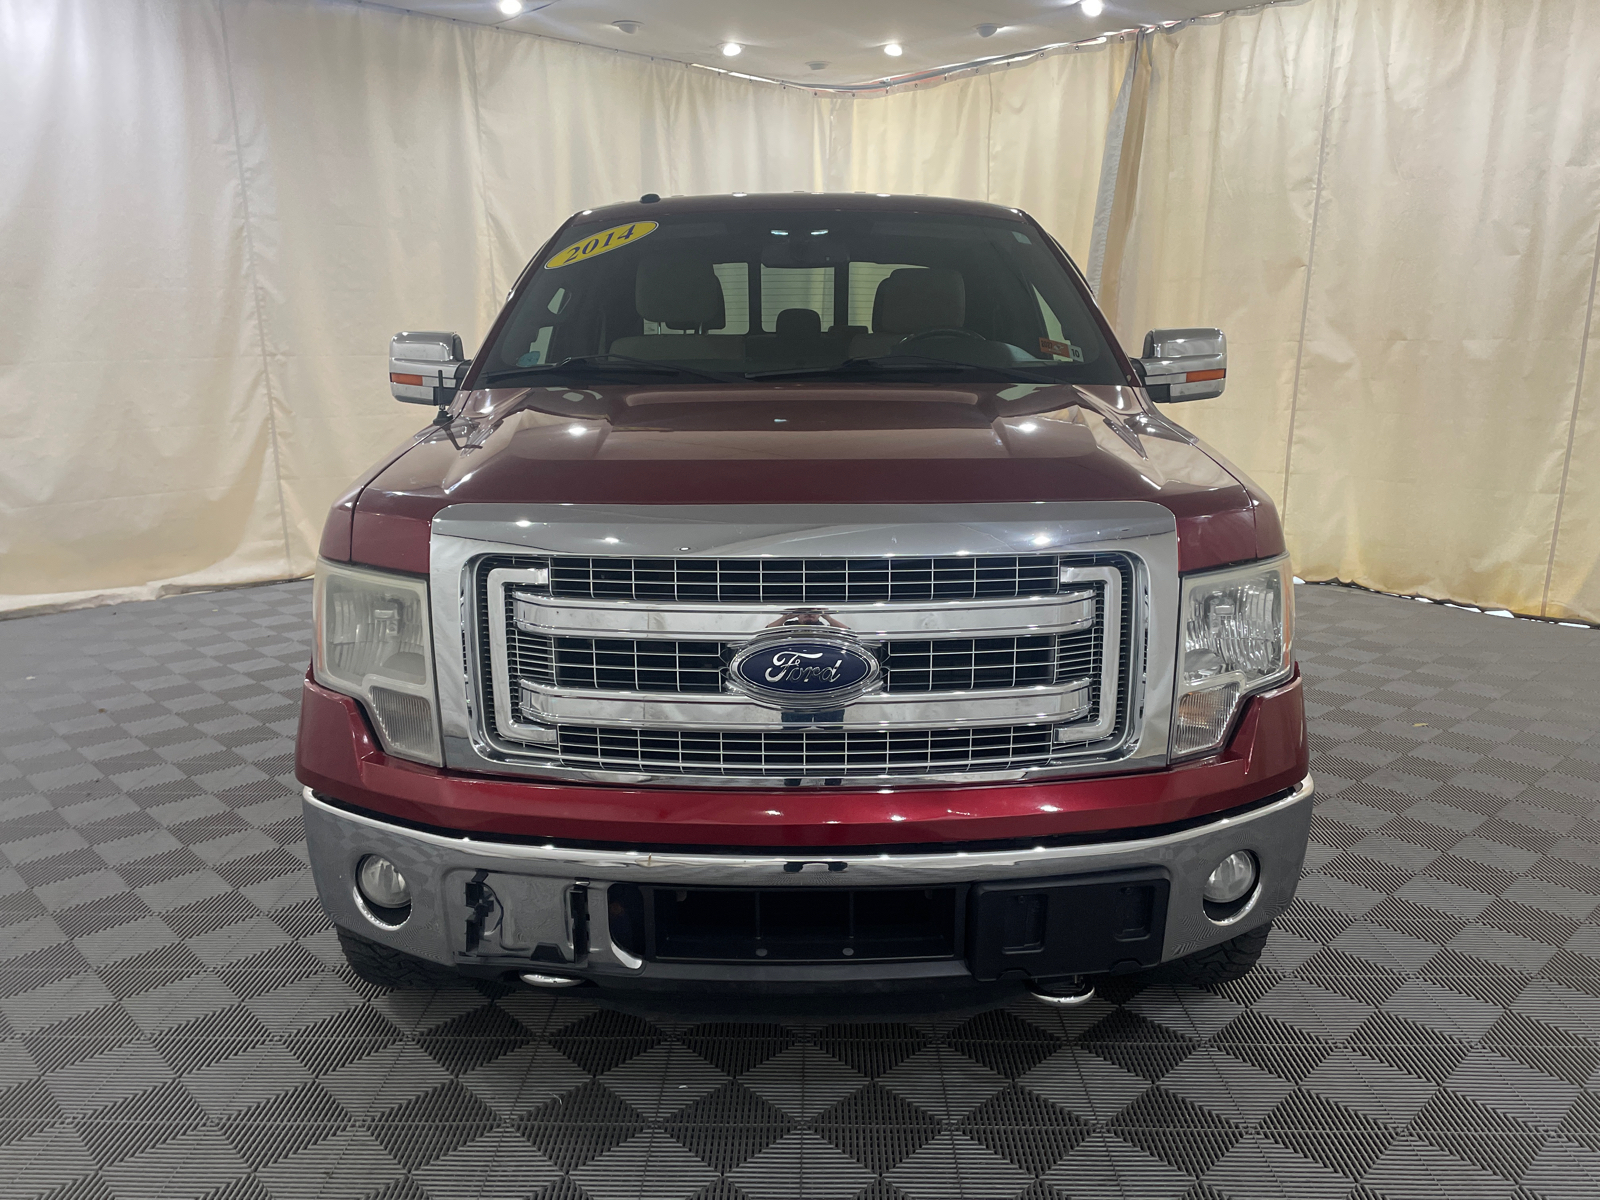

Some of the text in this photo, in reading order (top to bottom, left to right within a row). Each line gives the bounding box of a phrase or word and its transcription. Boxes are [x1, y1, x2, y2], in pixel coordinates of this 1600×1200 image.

[563, 224, 636, 264] 2014
[1071, 348, 1080, 358] 10
[764, 651, 843, 683] Ford
